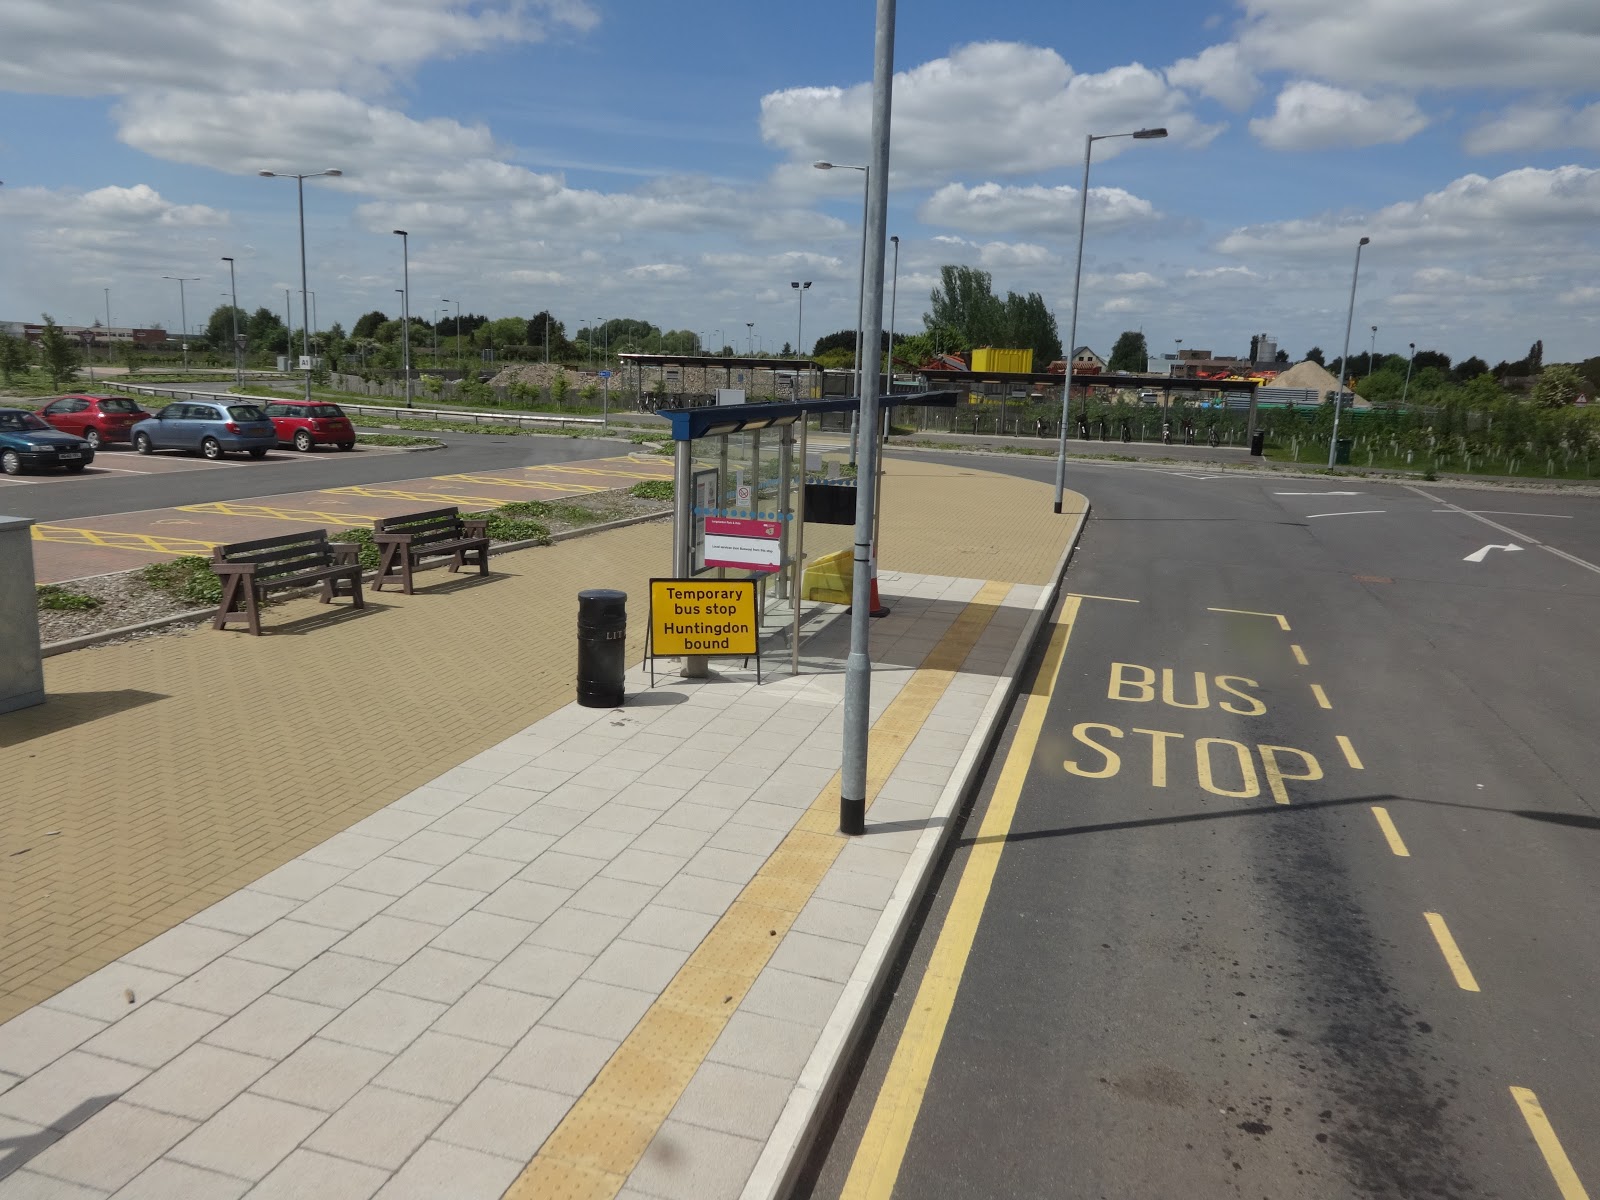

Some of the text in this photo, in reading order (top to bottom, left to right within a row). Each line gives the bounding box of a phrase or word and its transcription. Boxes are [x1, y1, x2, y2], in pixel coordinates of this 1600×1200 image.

[666, 587, 743, 601] Temporary
[674, 603, 737, 616] bus stop
[606, 630, 625, 640] LIT
[664, 622, 749, 636] Huntingdon
[684, 638, 730, 650] bound
[1107, 662, 1267, 716] BUS
[1063, 722, 1324, 805] STOP
